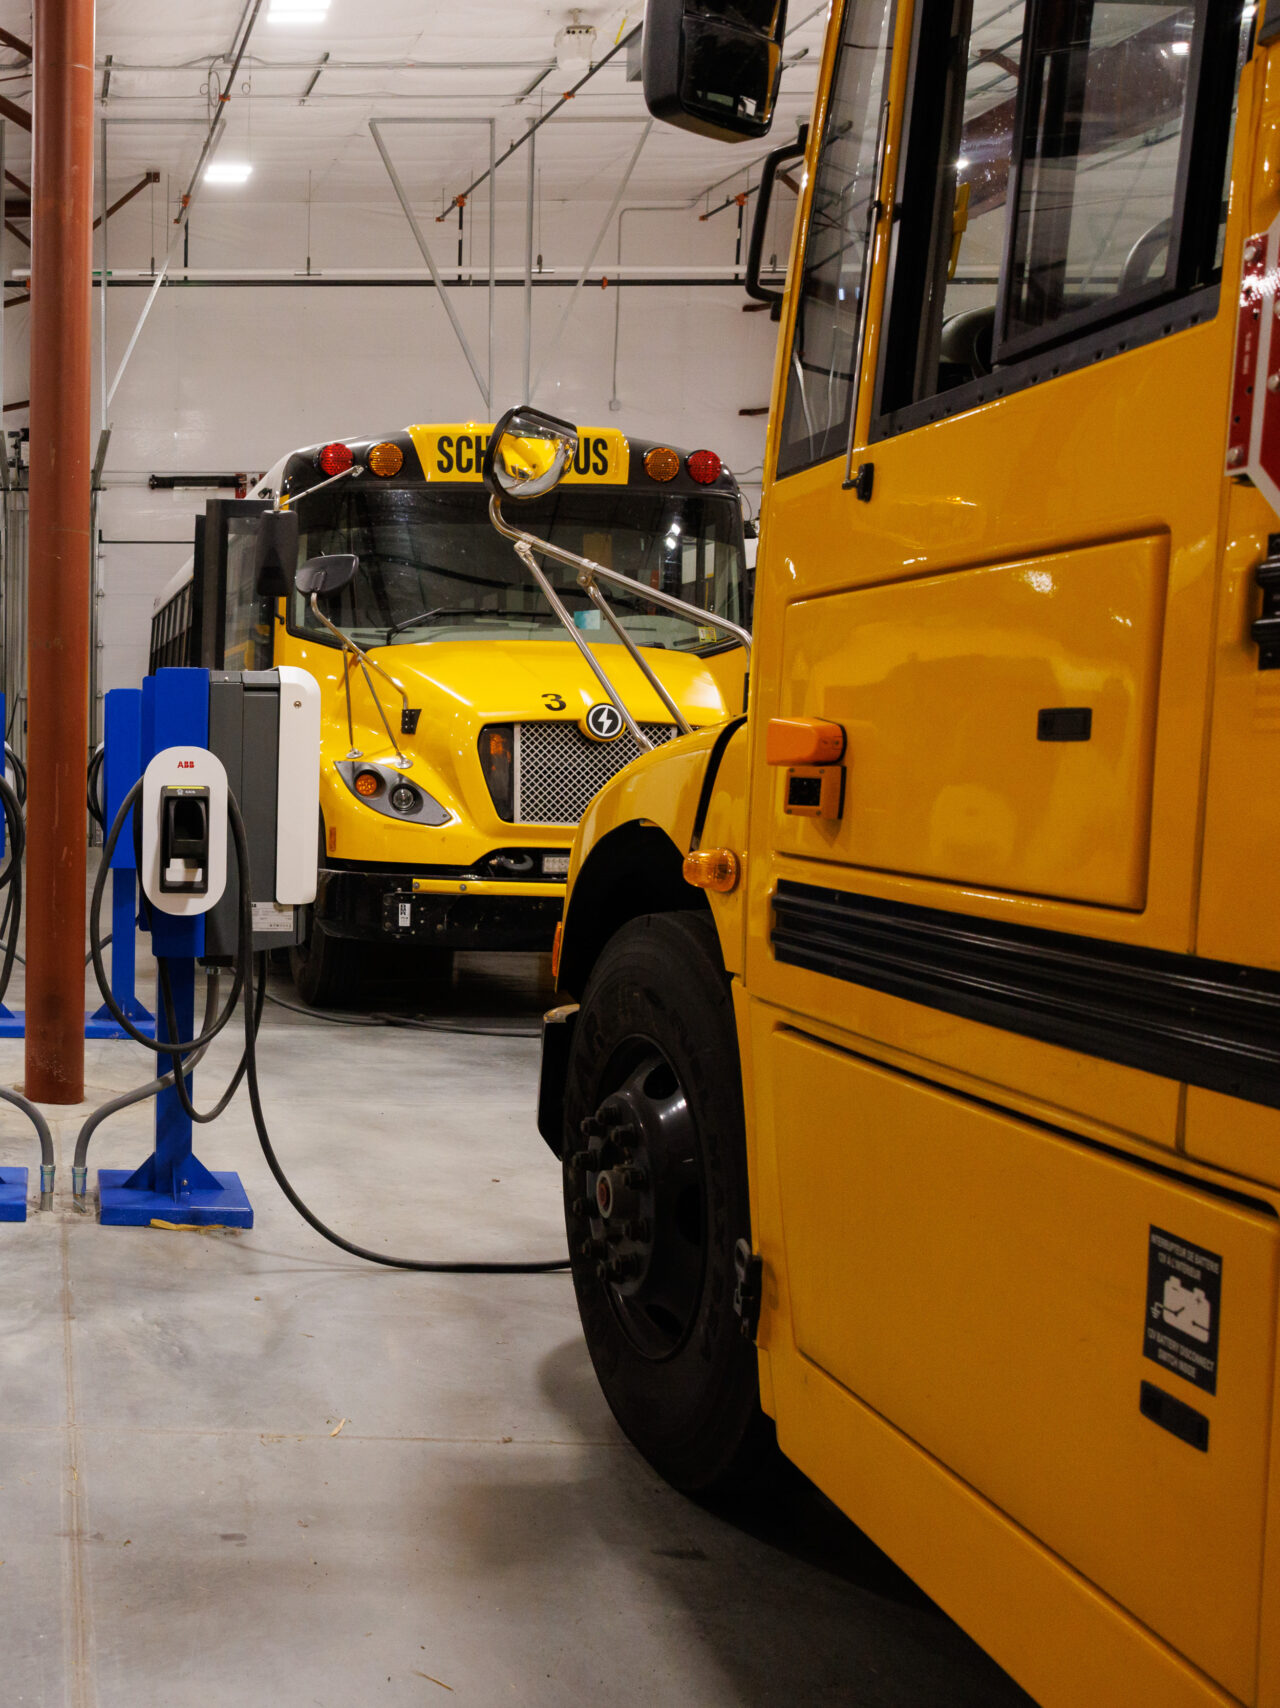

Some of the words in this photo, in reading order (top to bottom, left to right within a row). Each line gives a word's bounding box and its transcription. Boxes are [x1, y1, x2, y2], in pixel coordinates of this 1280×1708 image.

[437, 435, 491, 474] SCH
[573, 437, 609, 476] US
[541, 693, 567, 711] 3
[177, 760, 195, 769] ABB
[1156, 1331, 1180, 1353] BATTERY
[1179, 1344, 1215, 1372] DISCONNECT
